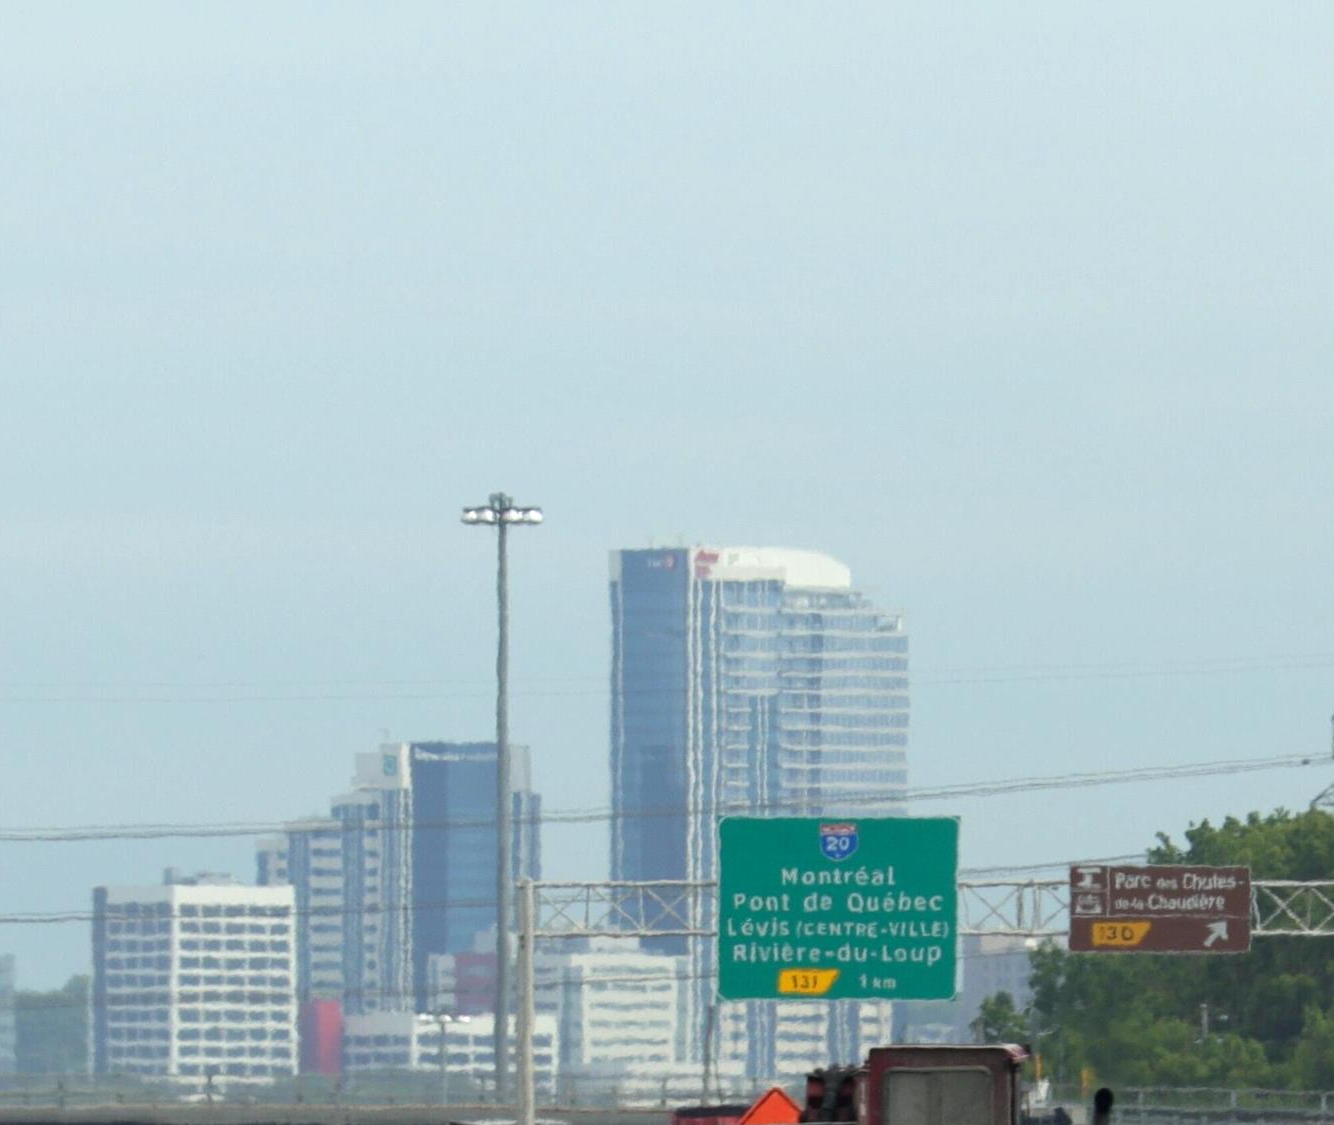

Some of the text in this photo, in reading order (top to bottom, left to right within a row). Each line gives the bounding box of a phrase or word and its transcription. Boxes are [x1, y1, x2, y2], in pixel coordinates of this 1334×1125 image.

[826, 836, 850, 851] 20
[781, 867, 897, 886] Montréal
[1115, 873, 1152, 889] Parc
[733, 893, 944, 913] Pont de Québec
[728, 918, 950, 938] Lévis (CENTRE-VILLE)
[733, 943, 942, 966] Rivière-du-Loup
[791, 974, 897, 990] 131 1 km
